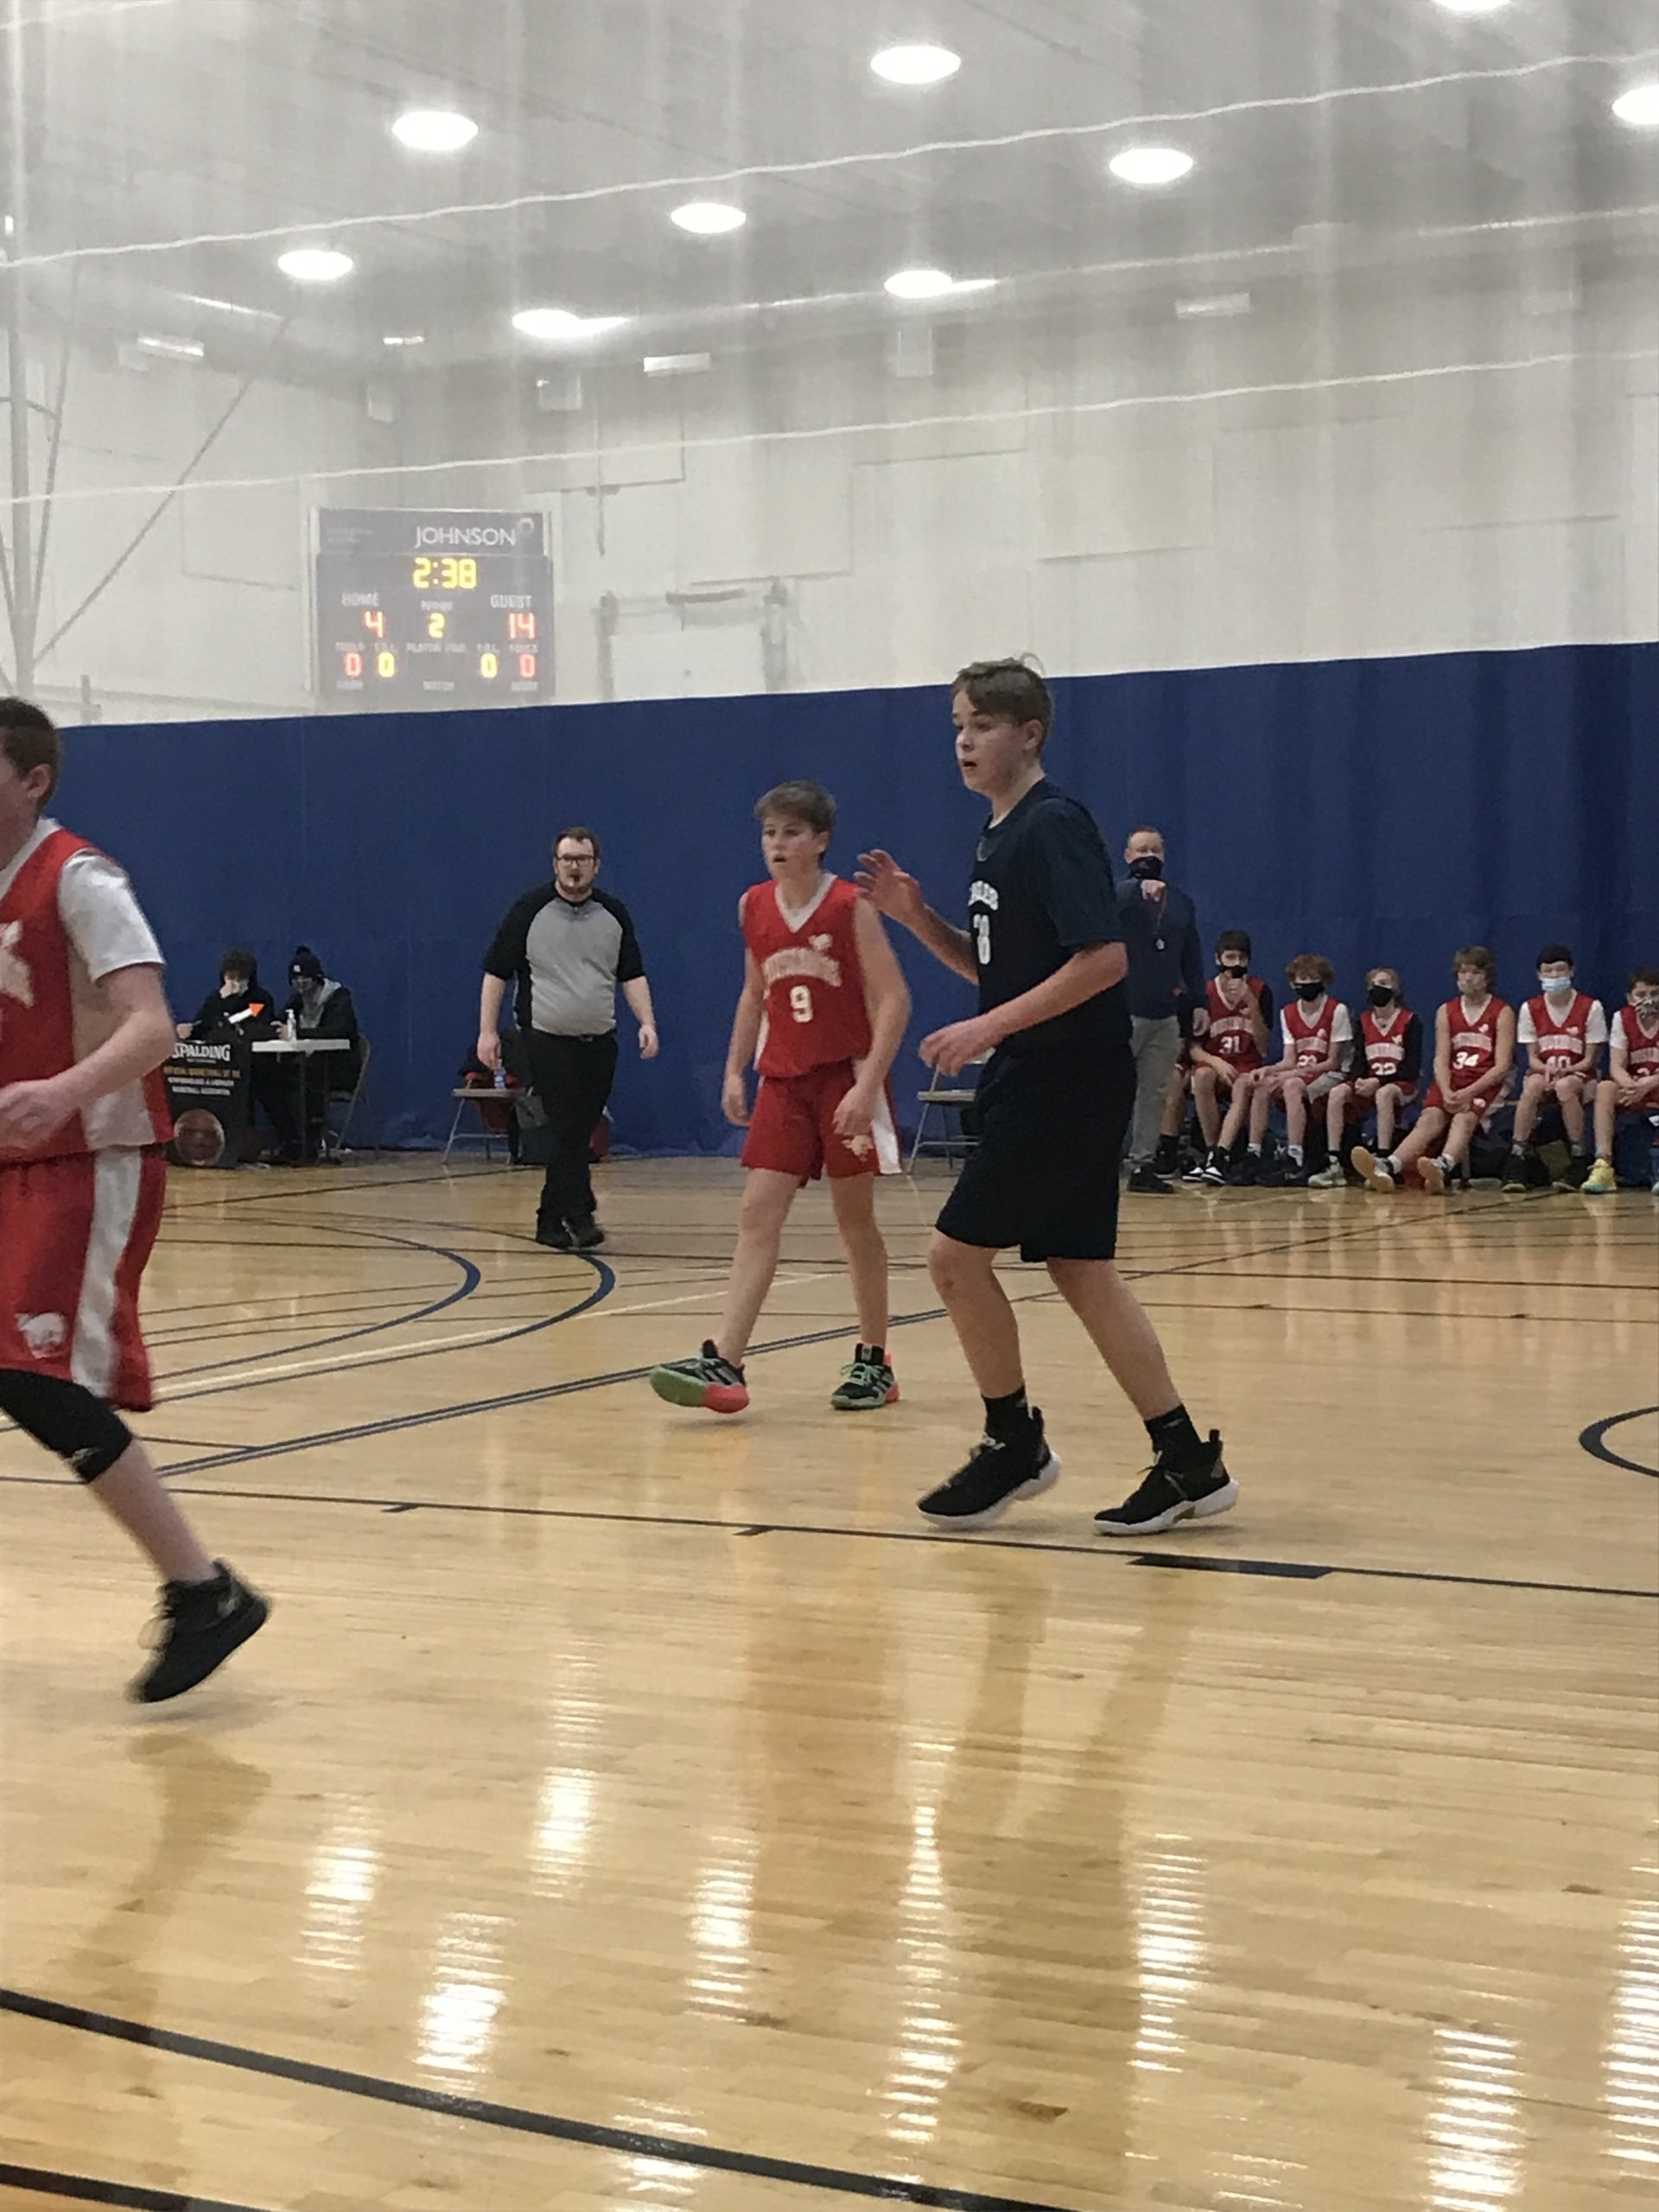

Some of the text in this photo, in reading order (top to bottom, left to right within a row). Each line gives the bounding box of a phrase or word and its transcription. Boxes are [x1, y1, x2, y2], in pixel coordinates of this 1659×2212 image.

[415, 526, 516, 549] JOHNSON
[413, 557, 477, 588] 2:38
[490, 594, 532, 608] GUEST
[364, 610, 385, 638] 4
[429, 612, 445, 638] 2
[508, 613, 536, 639] 14
[345, 652, 362, 677] 0
[378, 652, 395, 677] 0
[480, 653, 498, 678] 0
[518, 654, 536, 678] 0
[790, 985, 813, 1023] 9
[172, 1042, 231, 1062] SPALDING
[1452, 1051, 1479, 1070] 34
